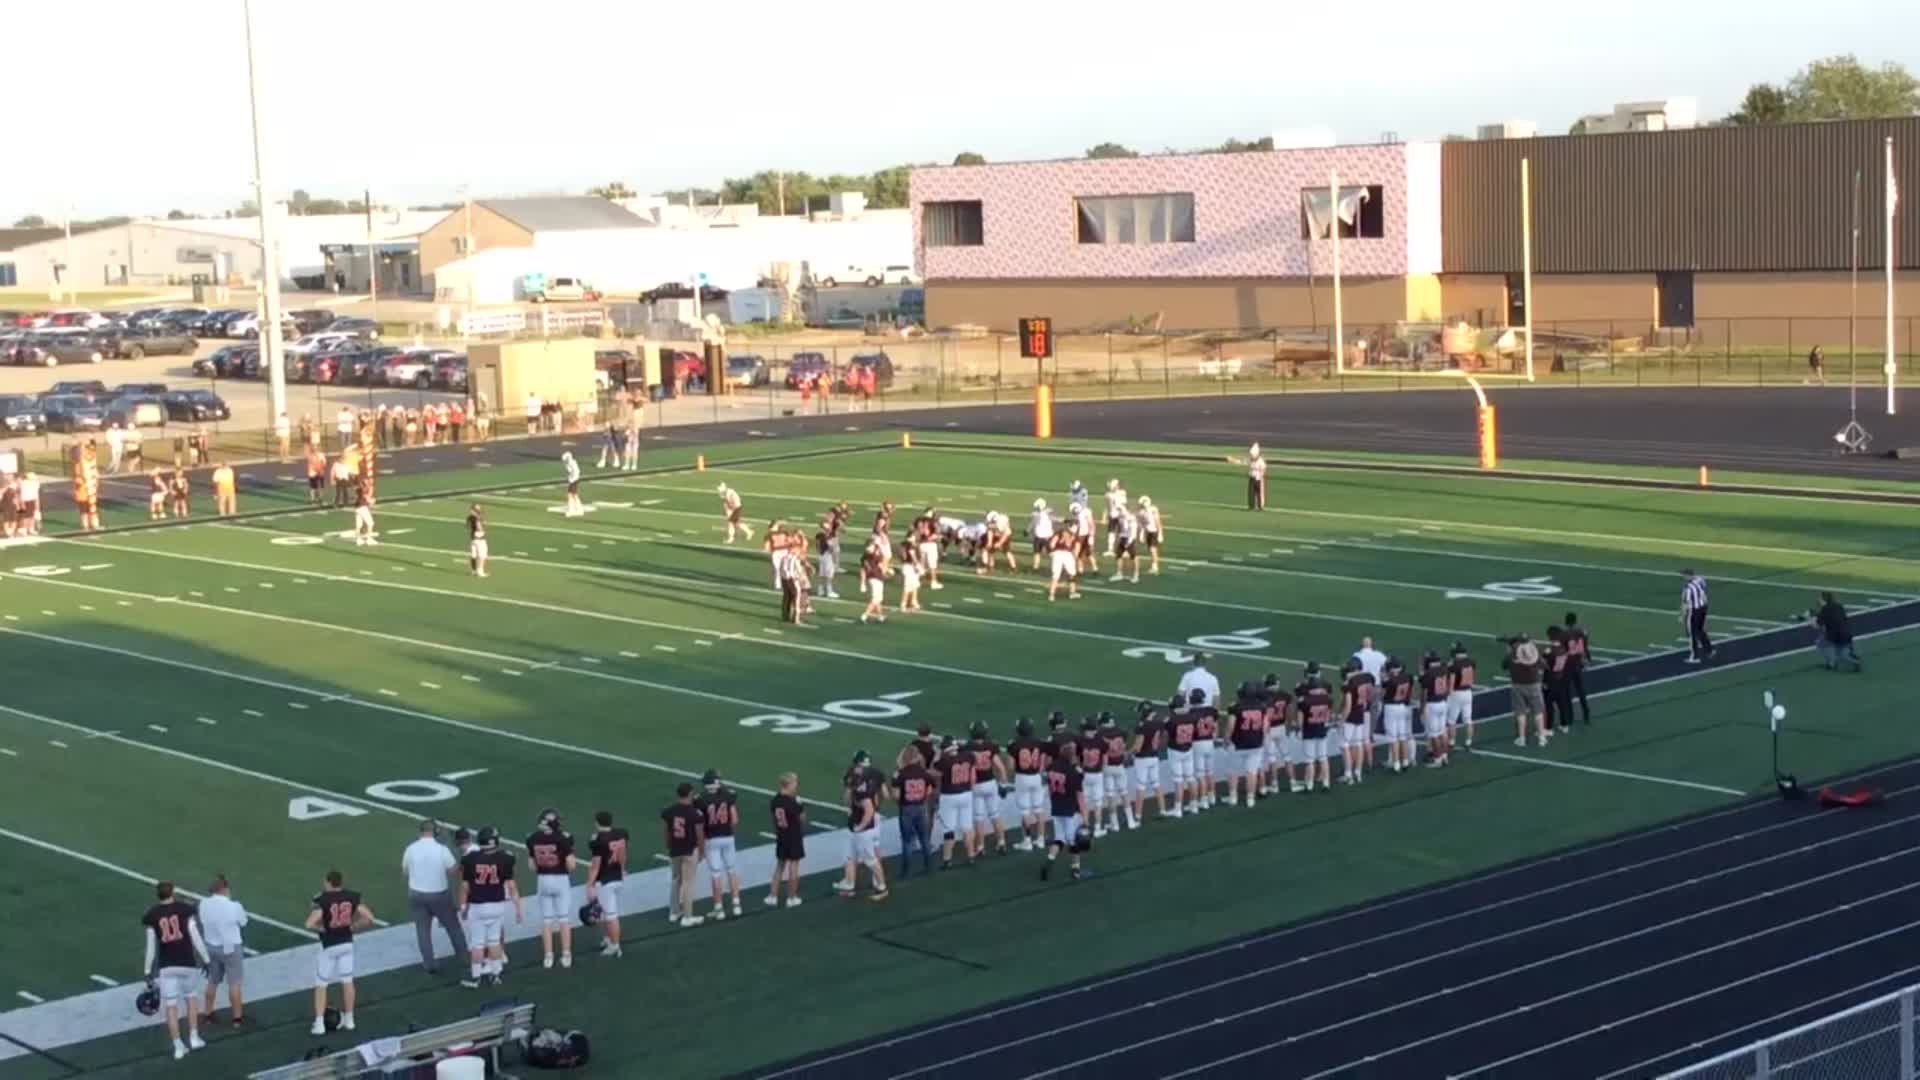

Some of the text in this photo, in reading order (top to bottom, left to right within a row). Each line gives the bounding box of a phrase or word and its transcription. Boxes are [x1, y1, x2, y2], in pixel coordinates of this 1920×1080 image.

[1445, 580, 1562, 601] 10
[1122, 634, 1271, 664] 20
[739, 699, 911, 735] 30
[288, 779, 461, 821] 40
[707, 802, 729, 825] 14
[672, 816, 686, 838] 5
[475, 863, 500, 885] 71
[158, 914, 184, 944] 11
